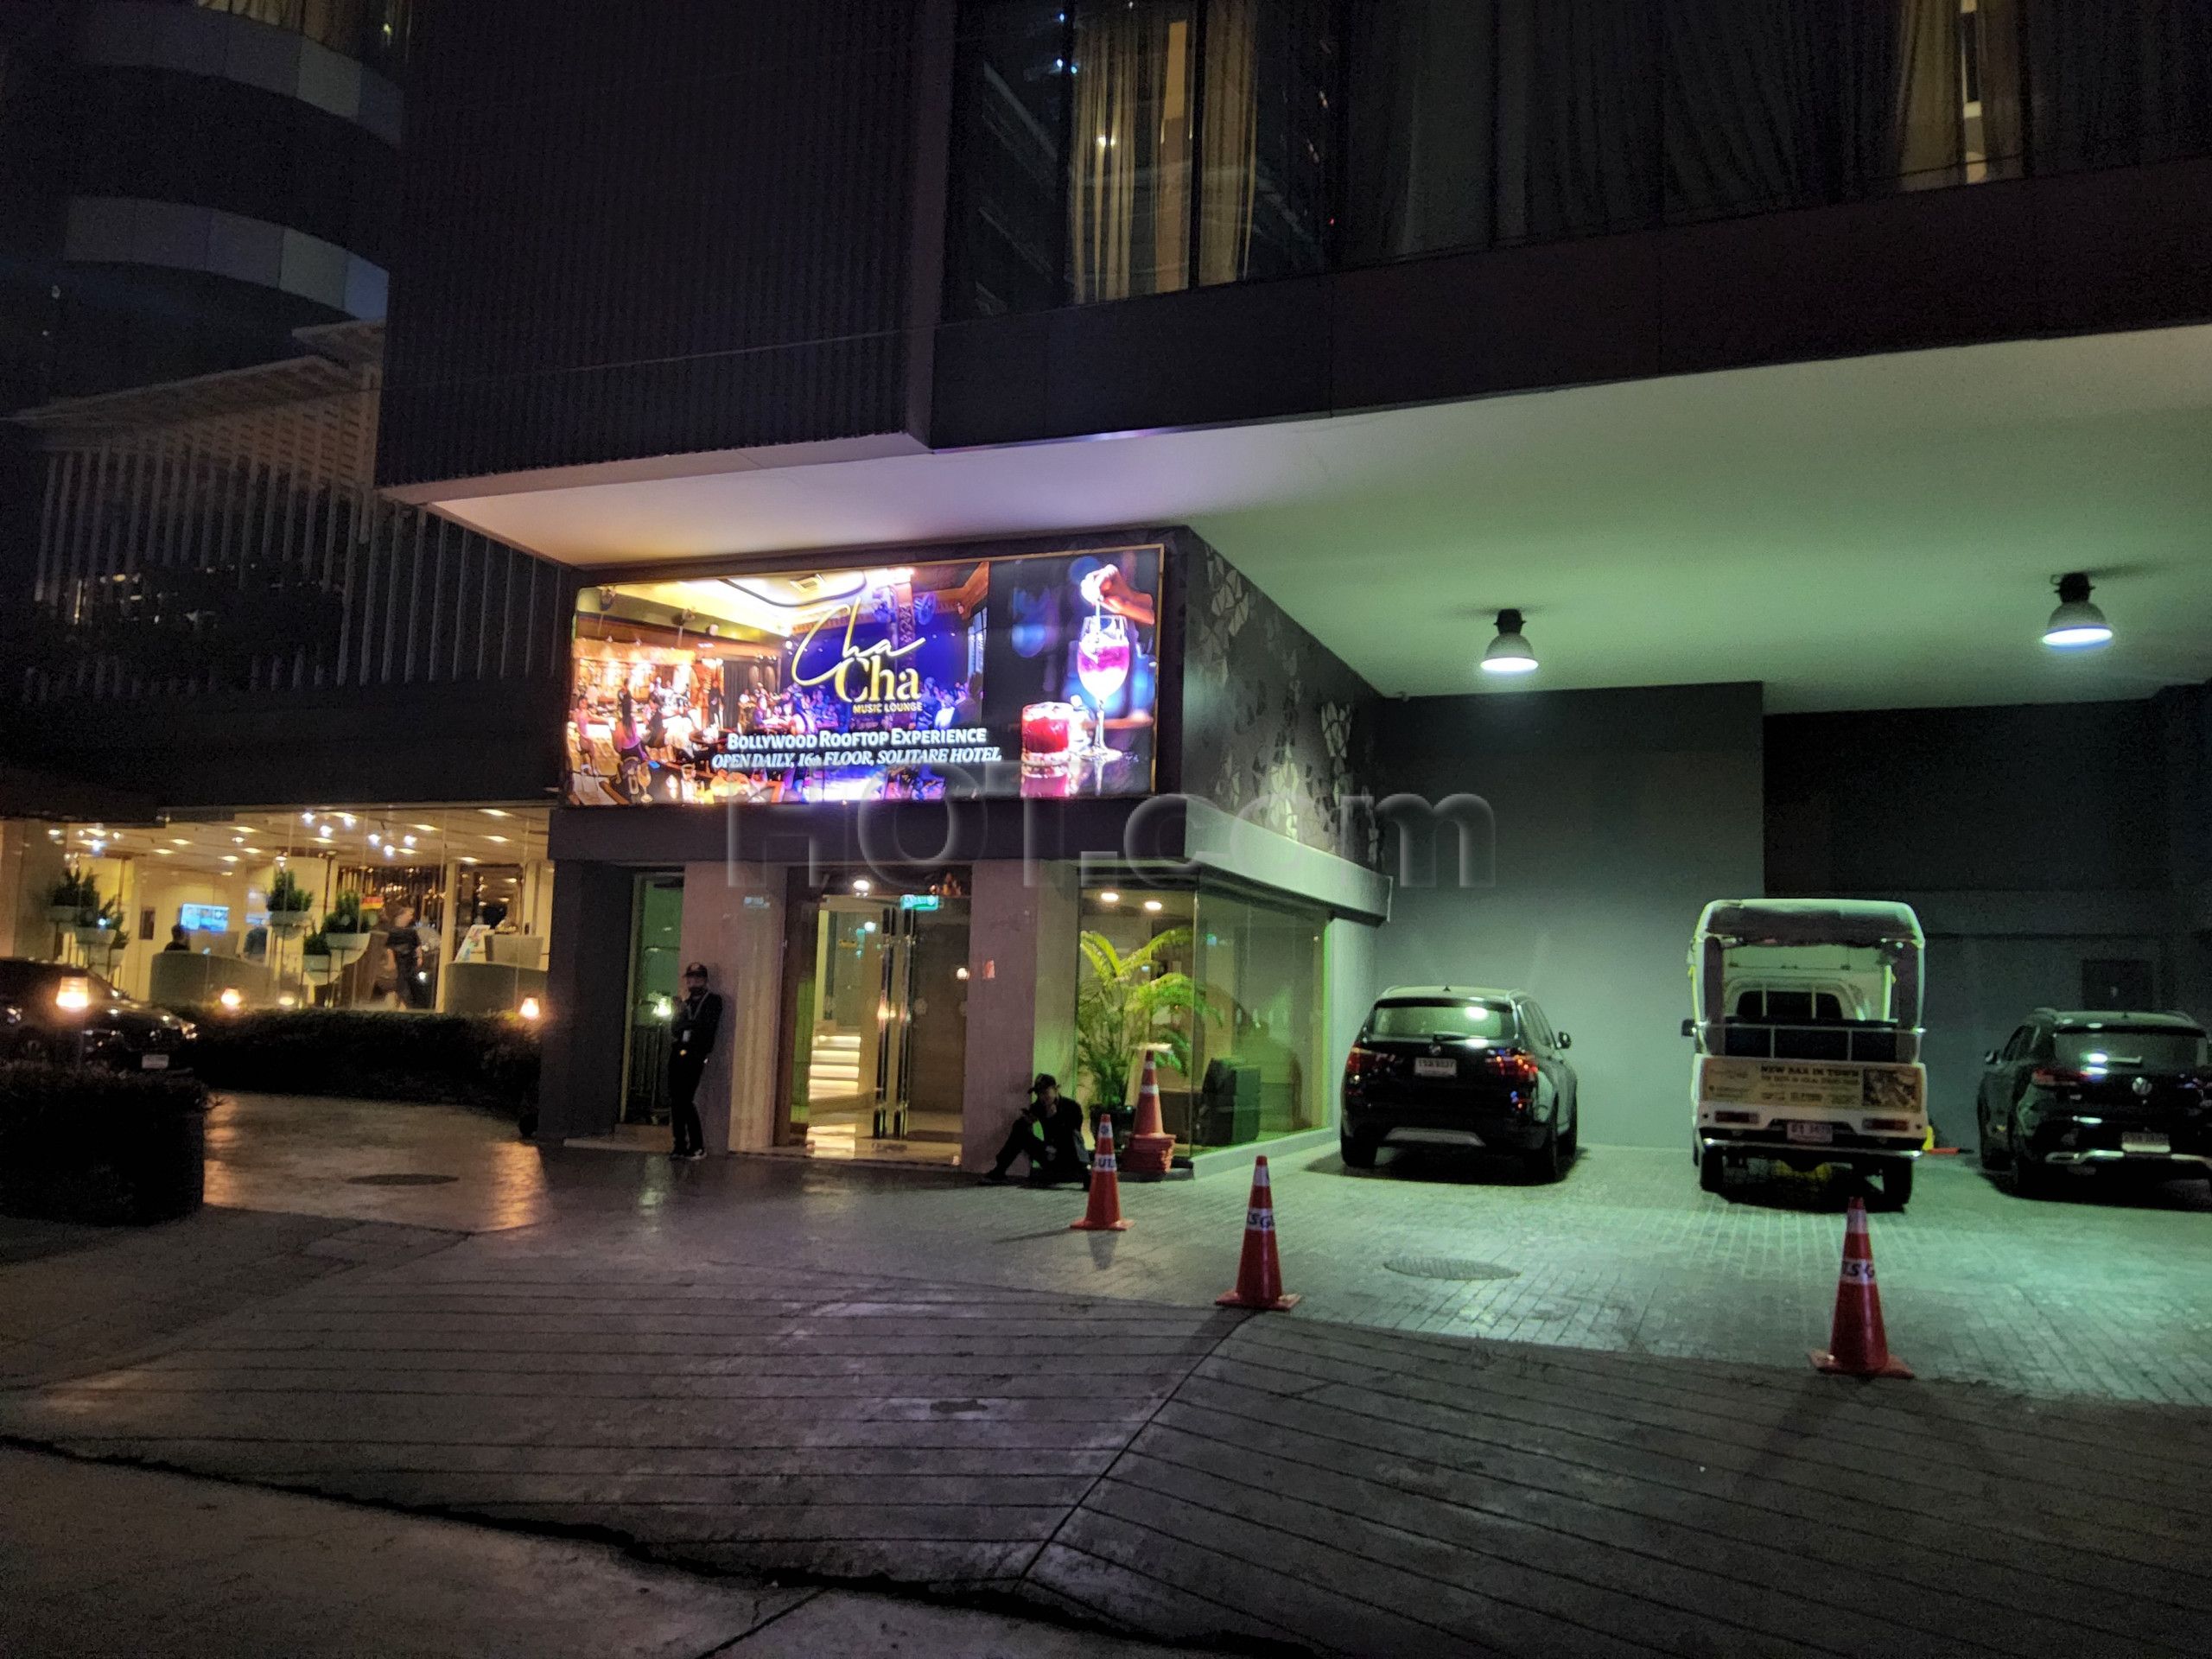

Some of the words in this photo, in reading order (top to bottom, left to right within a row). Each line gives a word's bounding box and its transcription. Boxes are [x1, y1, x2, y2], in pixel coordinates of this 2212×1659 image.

[835, 655, 922, 702] Cha
[853, 702, 883, 713] MUSIC
[885, 702, 923, 712] LOUNGE
[711, 753, 752, 769] OPEN
[752, 753, 795, 768] DAILY,
[823, 750, 875, 766] FLOOR,
[950, 747, 1002, 762] HOTEL
